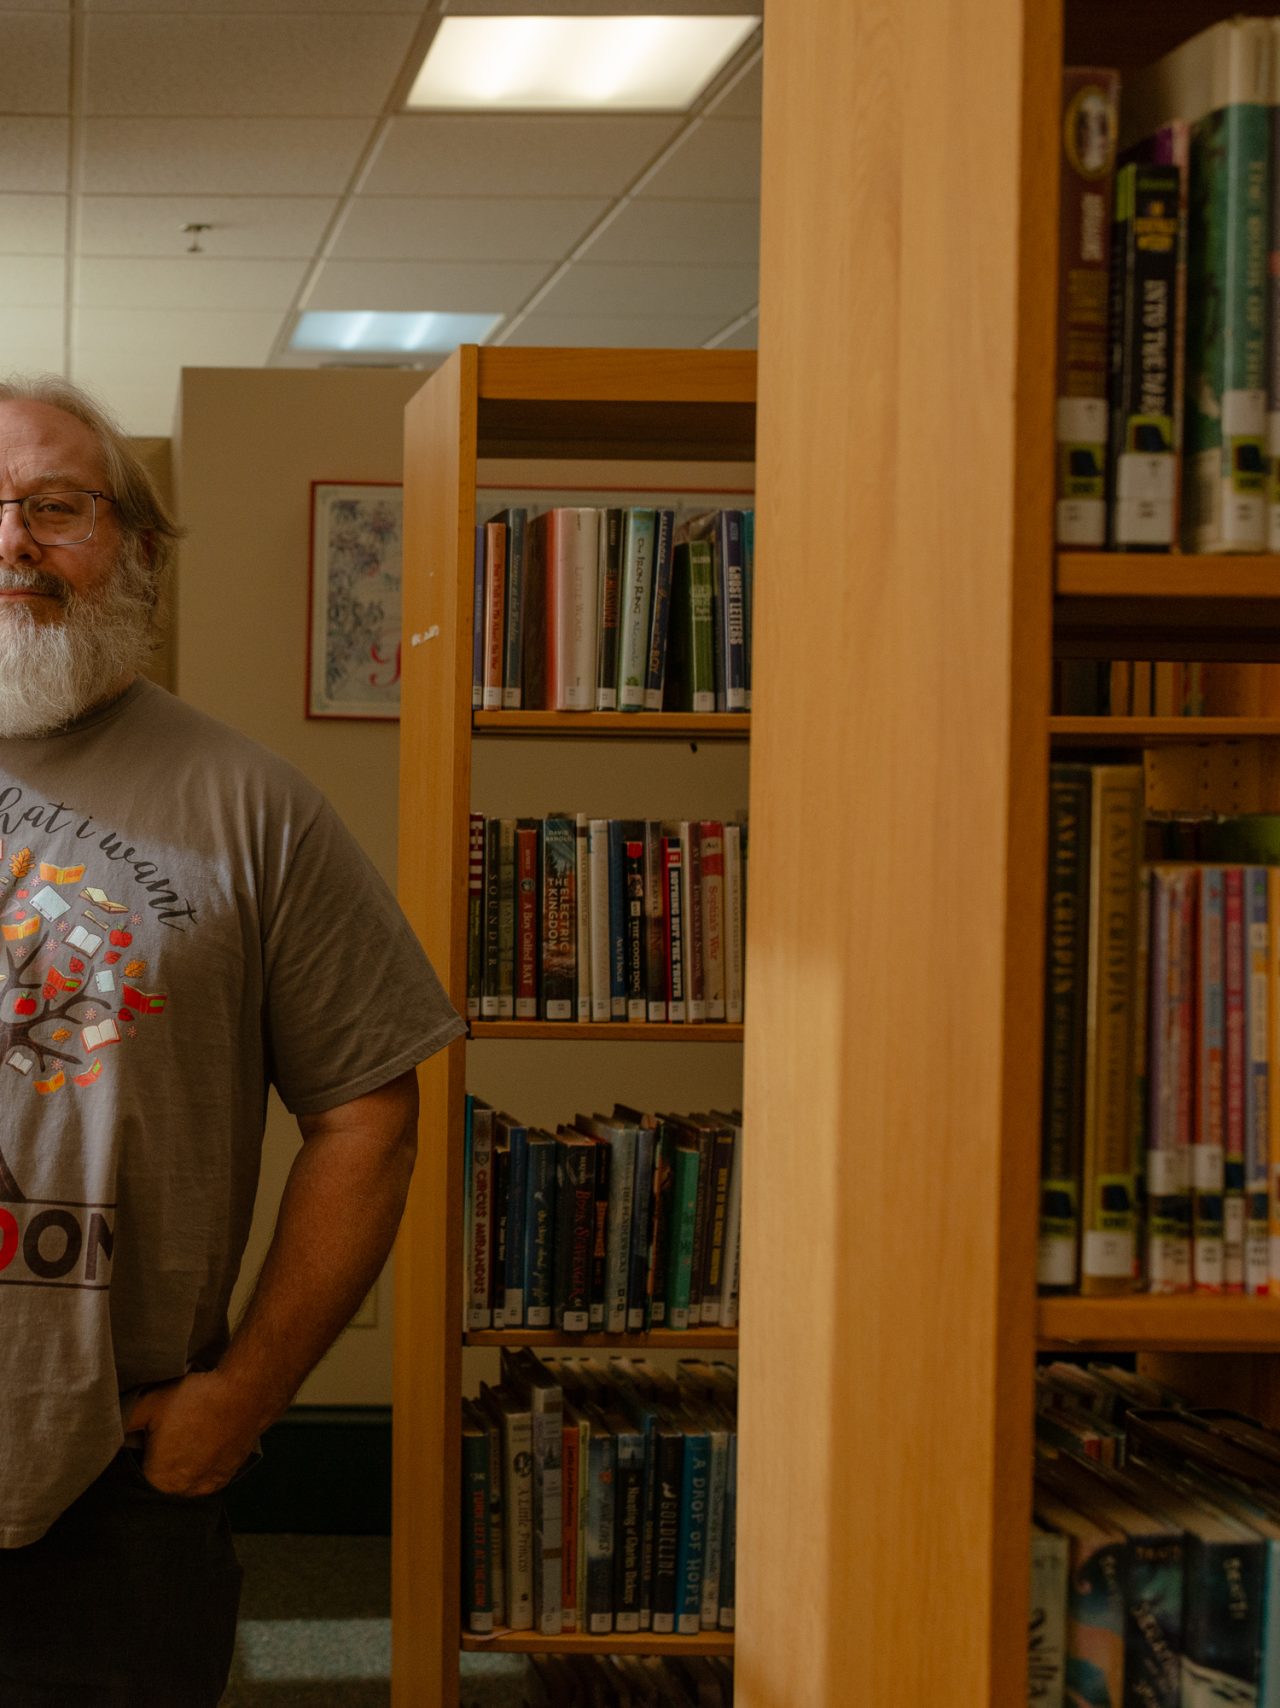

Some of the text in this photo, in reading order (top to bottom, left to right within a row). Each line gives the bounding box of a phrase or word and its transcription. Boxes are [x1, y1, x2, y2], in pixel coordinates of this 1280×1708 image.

[633, 585, 644, 614] RING
[728, 566, 743, 600] GHOST
[728, 601, 742, 645] LETTERS
[98, 828, 198, 933] want
[488, 874, 497, 967] SOUNDER
[547, 887, 559, 951] KINGDOM
[559, 887, 570, 953] ELECTRIC
[632, 940, 640, 968] GOOD
[709, 935, 720, 961] War
[522, 963, 532, 986] BAT
[632, 970, 641, 993] DOG
[671, 962, 682, 998] TRUTH
[473, 1168, 487, 1294] CIRCUS MIRANDUS
[657, 1501, 676, 1577] GOLDELINE
[685, 1457, 705, 1605] A DROP OF HOPE
